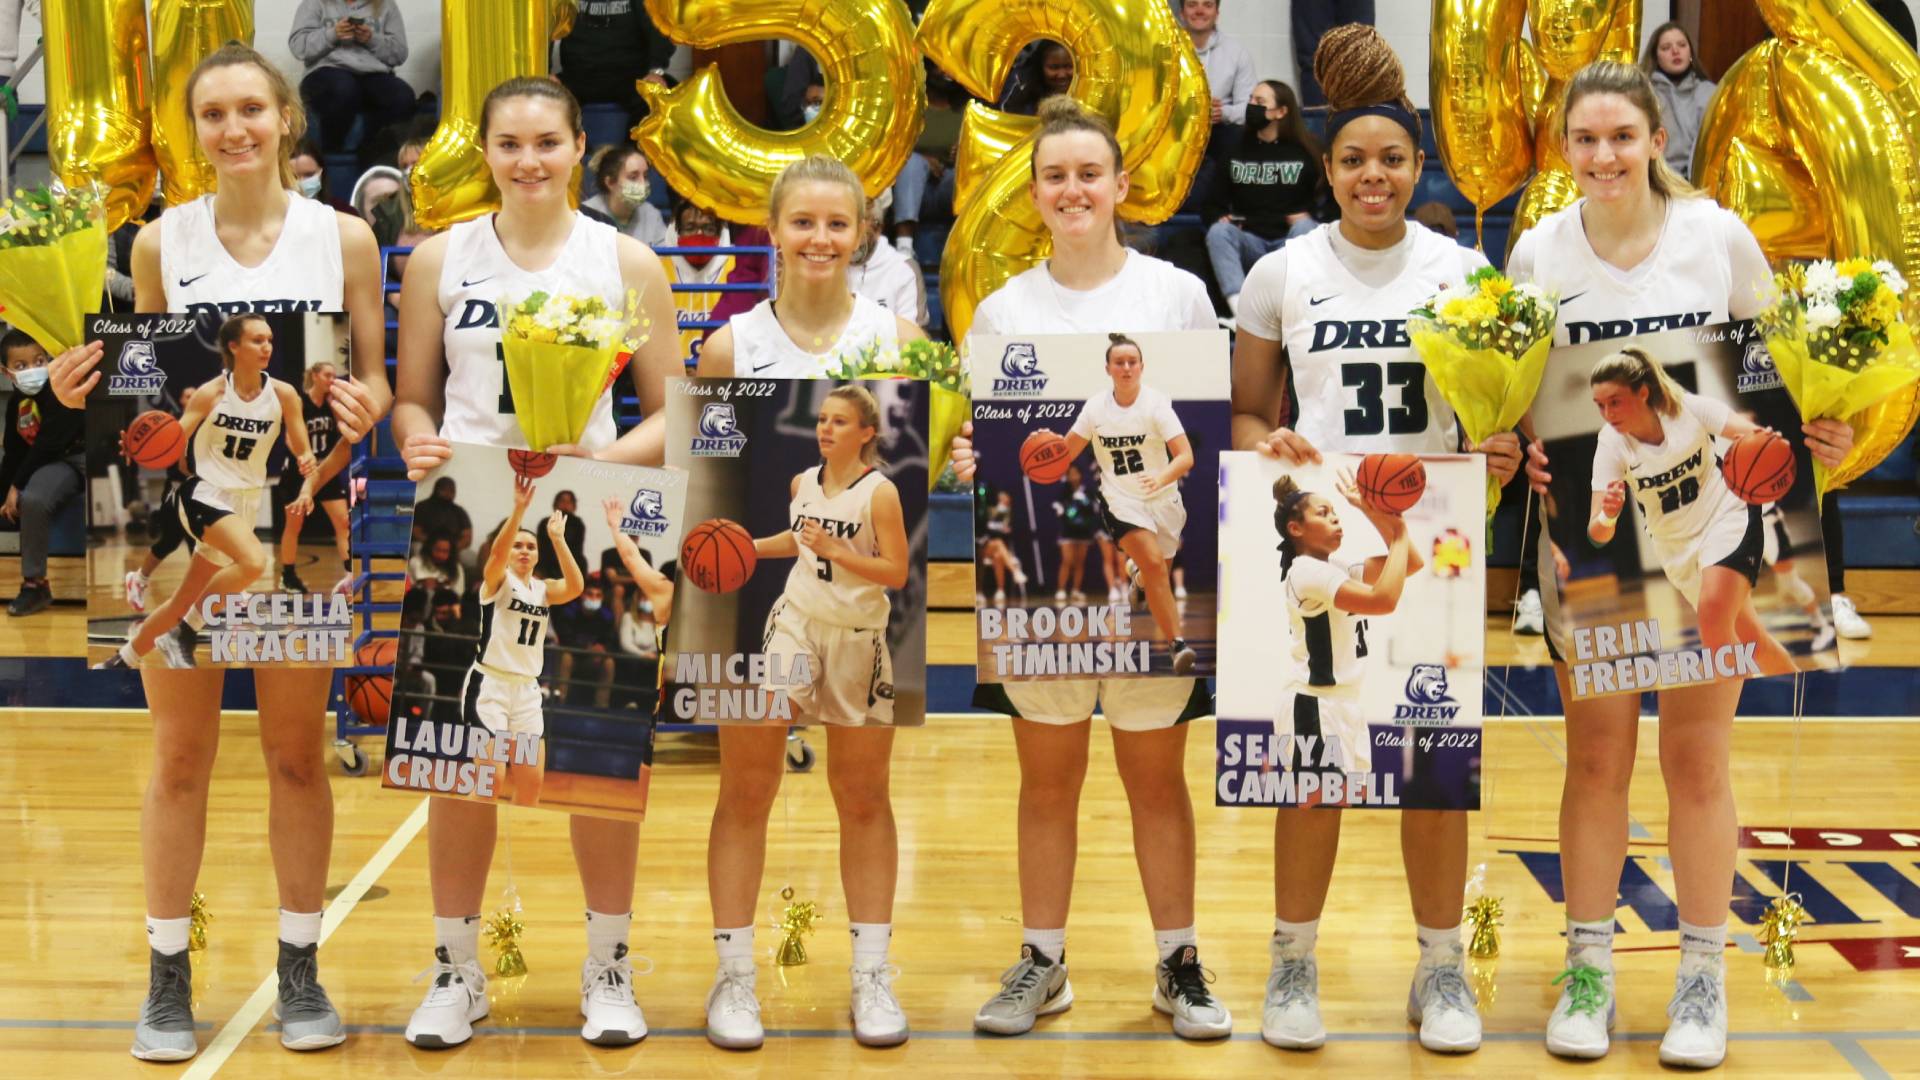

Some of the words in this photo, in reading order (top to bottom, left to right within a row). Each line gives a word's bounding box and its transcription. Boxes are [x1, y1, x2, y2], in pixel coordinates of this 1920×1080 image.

[1230, 159, 1304, 185] DREW
[93, 318, 132, 335] Class
[136, 319, 152, 339] of
[155, 319, 197, 334] 2022
[1308, 319, 1412, 353] DRE
[1730, 323, 1745, 345] of
[110, 375, 166, 391] DREW
[716, 381, 732, 402] of
[735, 382, 777, 397] 2022
[992, 377, 1049, 392] DREW
[1341, 361, 1430, 437] 33
[213, 413, 274, 435] DREW
[974, 404, 1013, 420] Class
[1017, 406, 1032, 425] of
[1037, 403, 1076, 419] 2022
[222, 435, 257, 461] 15
[689, 437, 746, 451] DREW
[1099, 434, 1147, 448] DREW
[1110, 448, 1145, 476] 22
[1636, 447, 1702, 492] DREW
[620, 517, 670, 534] DREW
[202, 592, 351, 626] CECELIA
[507, 598, 550, 618] DREW
[517, 618, 541, 646] 11
[980, 605, 1132, 640] BROOKE
[211, 629, 350, 663] KRACHT
[1573, 618, 1662, 661] ERIN
[674, 653, 813, 684] MICELA
[992, 641, 1150, 675] TIMINSKI
[1573, 641, 1761, 697] FREDERICK
[673, 688, 793, 721] GENUA
[1393, 703, 1461, 721] DREW
[394, 716, 542, 767] LAUREN
[1223, 733, 1345, 769] SEKYA
[1374, 730, 1416, 747] Class
[1418, 733, 1434, 752] of
[1437, 732, 1479, 749] 2022
[387, 753, 497, 799] CRUSE
[1217, 770, 1400, 806] CAMPBELL
